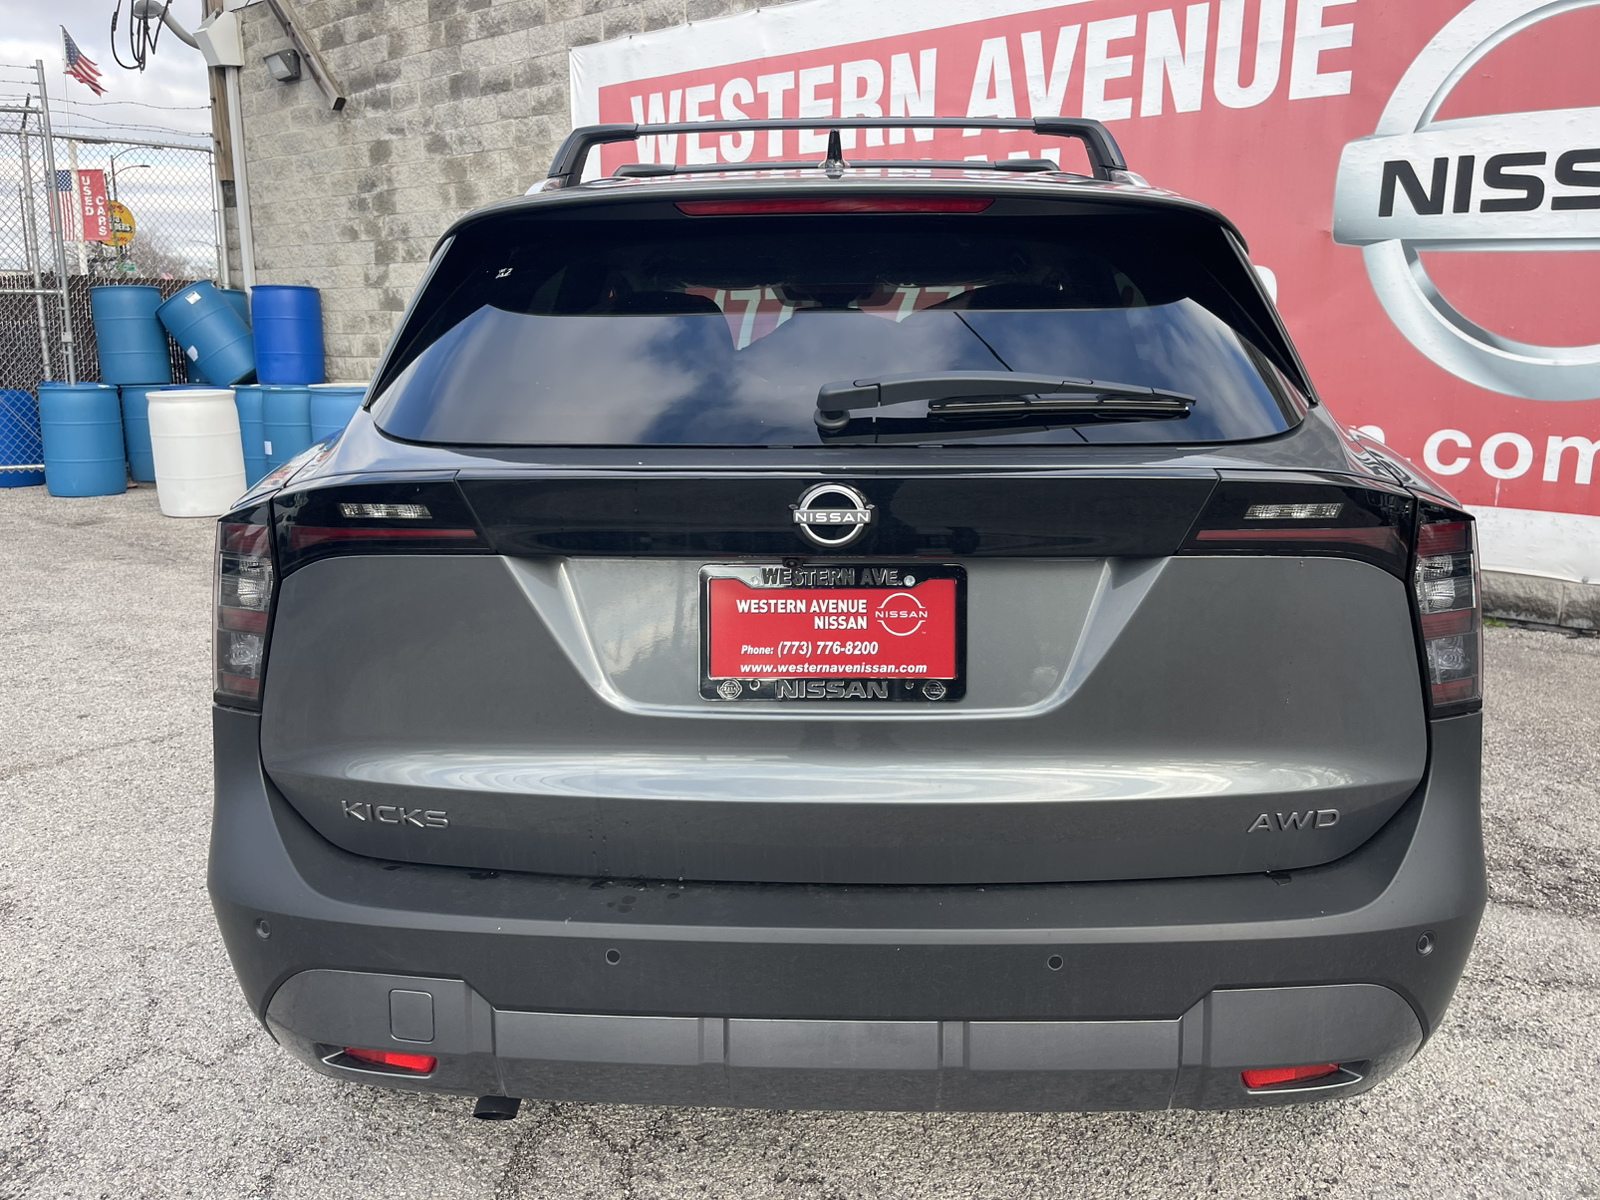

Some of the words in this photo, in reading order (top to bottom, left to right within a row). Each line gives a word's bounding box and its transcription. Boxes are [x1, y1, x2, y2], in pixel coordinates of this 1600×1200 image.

[631, 47, 937, 166] WESTERN
[962, 0, 1356, 138] AVENUE
[81, 175, 95, 216] USED
[95, 195, 108, 236] CARS
[795, 512, 869, 523] NISSAN
[761, 567, 855, 586] WESTERN
[860, 567, 903, 586] AVE.
[736, 599, 806, 613] WESTERN
[809, 599, 867, 613] AVENUE
[875, 610, 928, 619] NISSAN
[814, 615, 867, 630] NISSAN
[741, 644, 774, 655] Phone:
[777, 641, 812, 658] (773)
[816, 641, 879, 655] 776-8200
[740, 662, 928, 673] www.westernavenissan.com
[777, 680, 889, 699] NISSAN
[341, 800, 449, 829] KICKS
[1246, 808, 1340, 833] AWD
